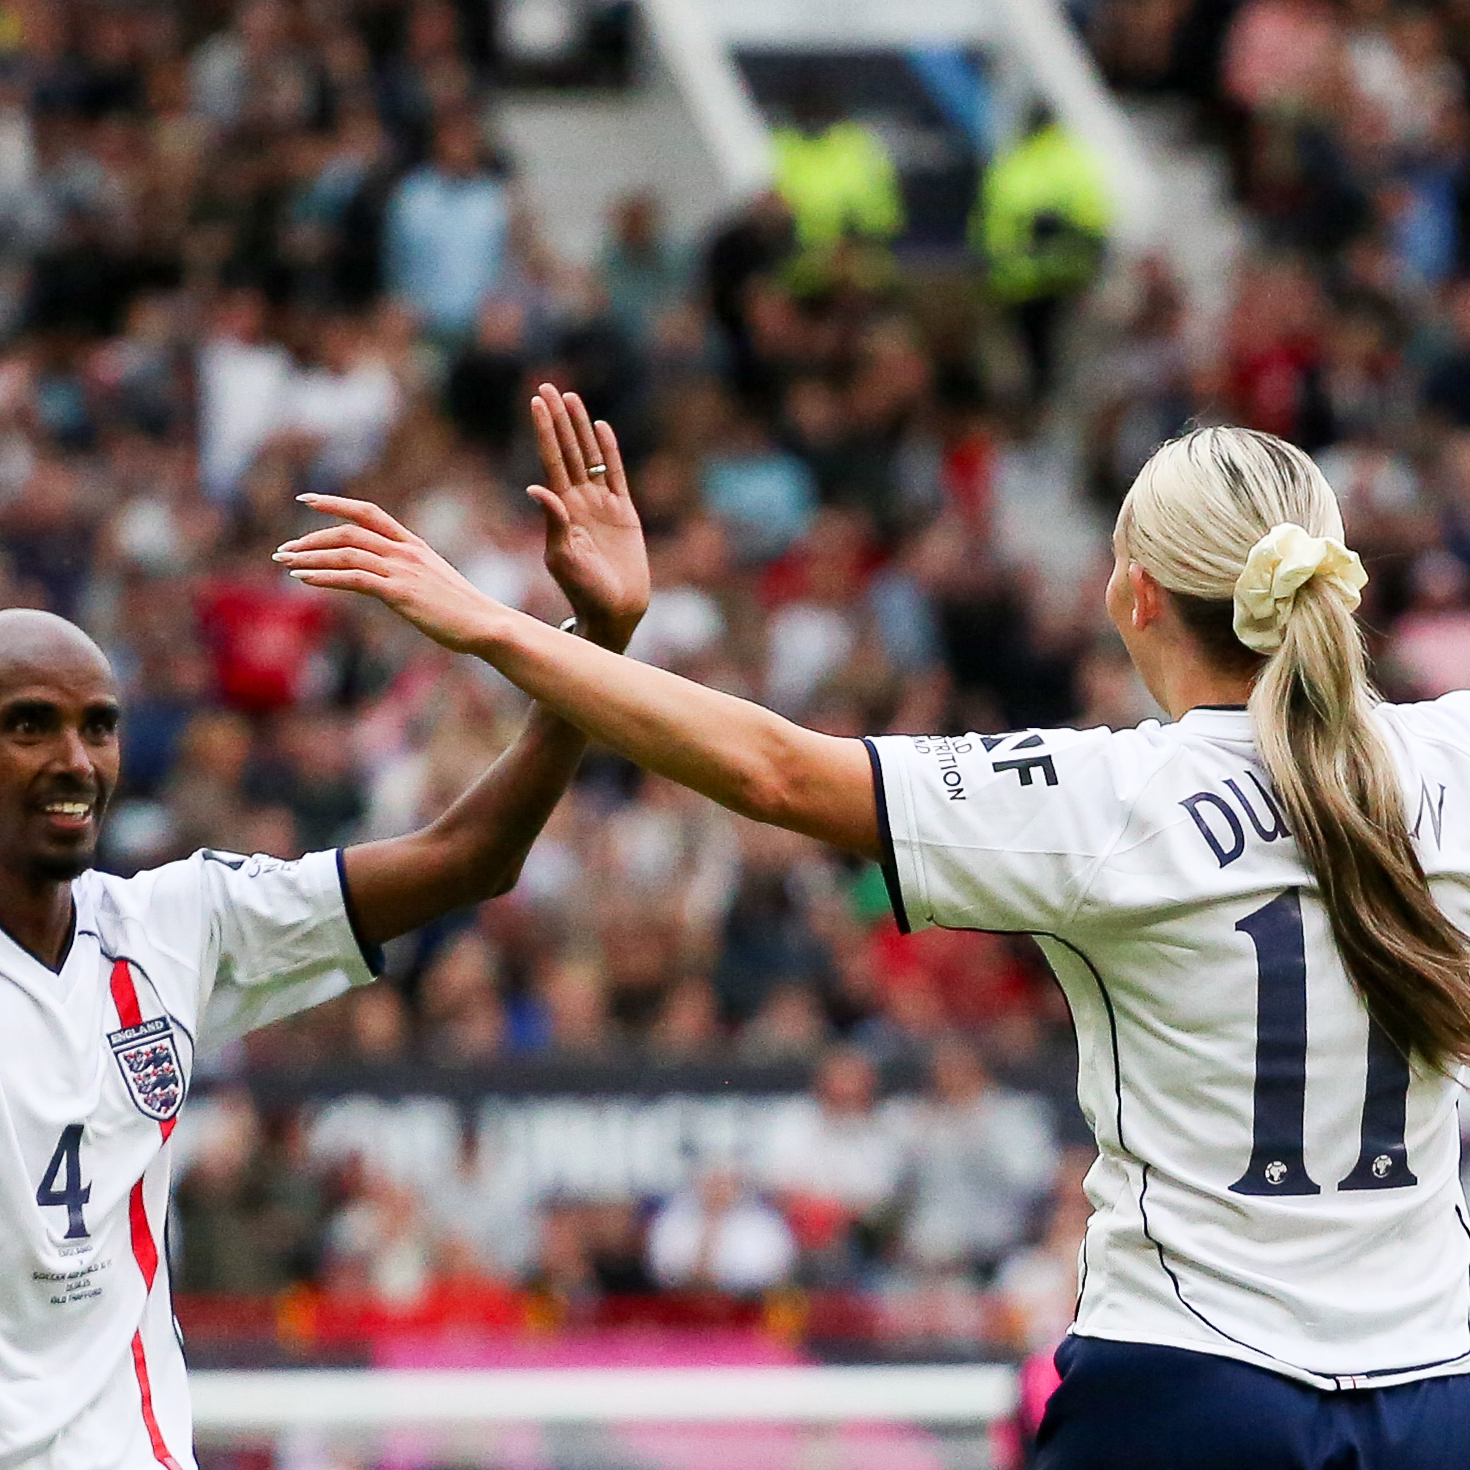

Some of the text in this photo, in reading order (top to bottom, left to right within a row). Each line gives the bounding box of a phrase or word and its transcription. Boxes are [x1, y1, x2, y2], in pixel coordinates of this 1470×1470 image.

[1178, 770, 1446, 869] DUN
[111, 1020, 165, 1046] ENGLAND
[1227, 885, 1418, 1195] 11
[36, 1124, 92, 1239] 4
